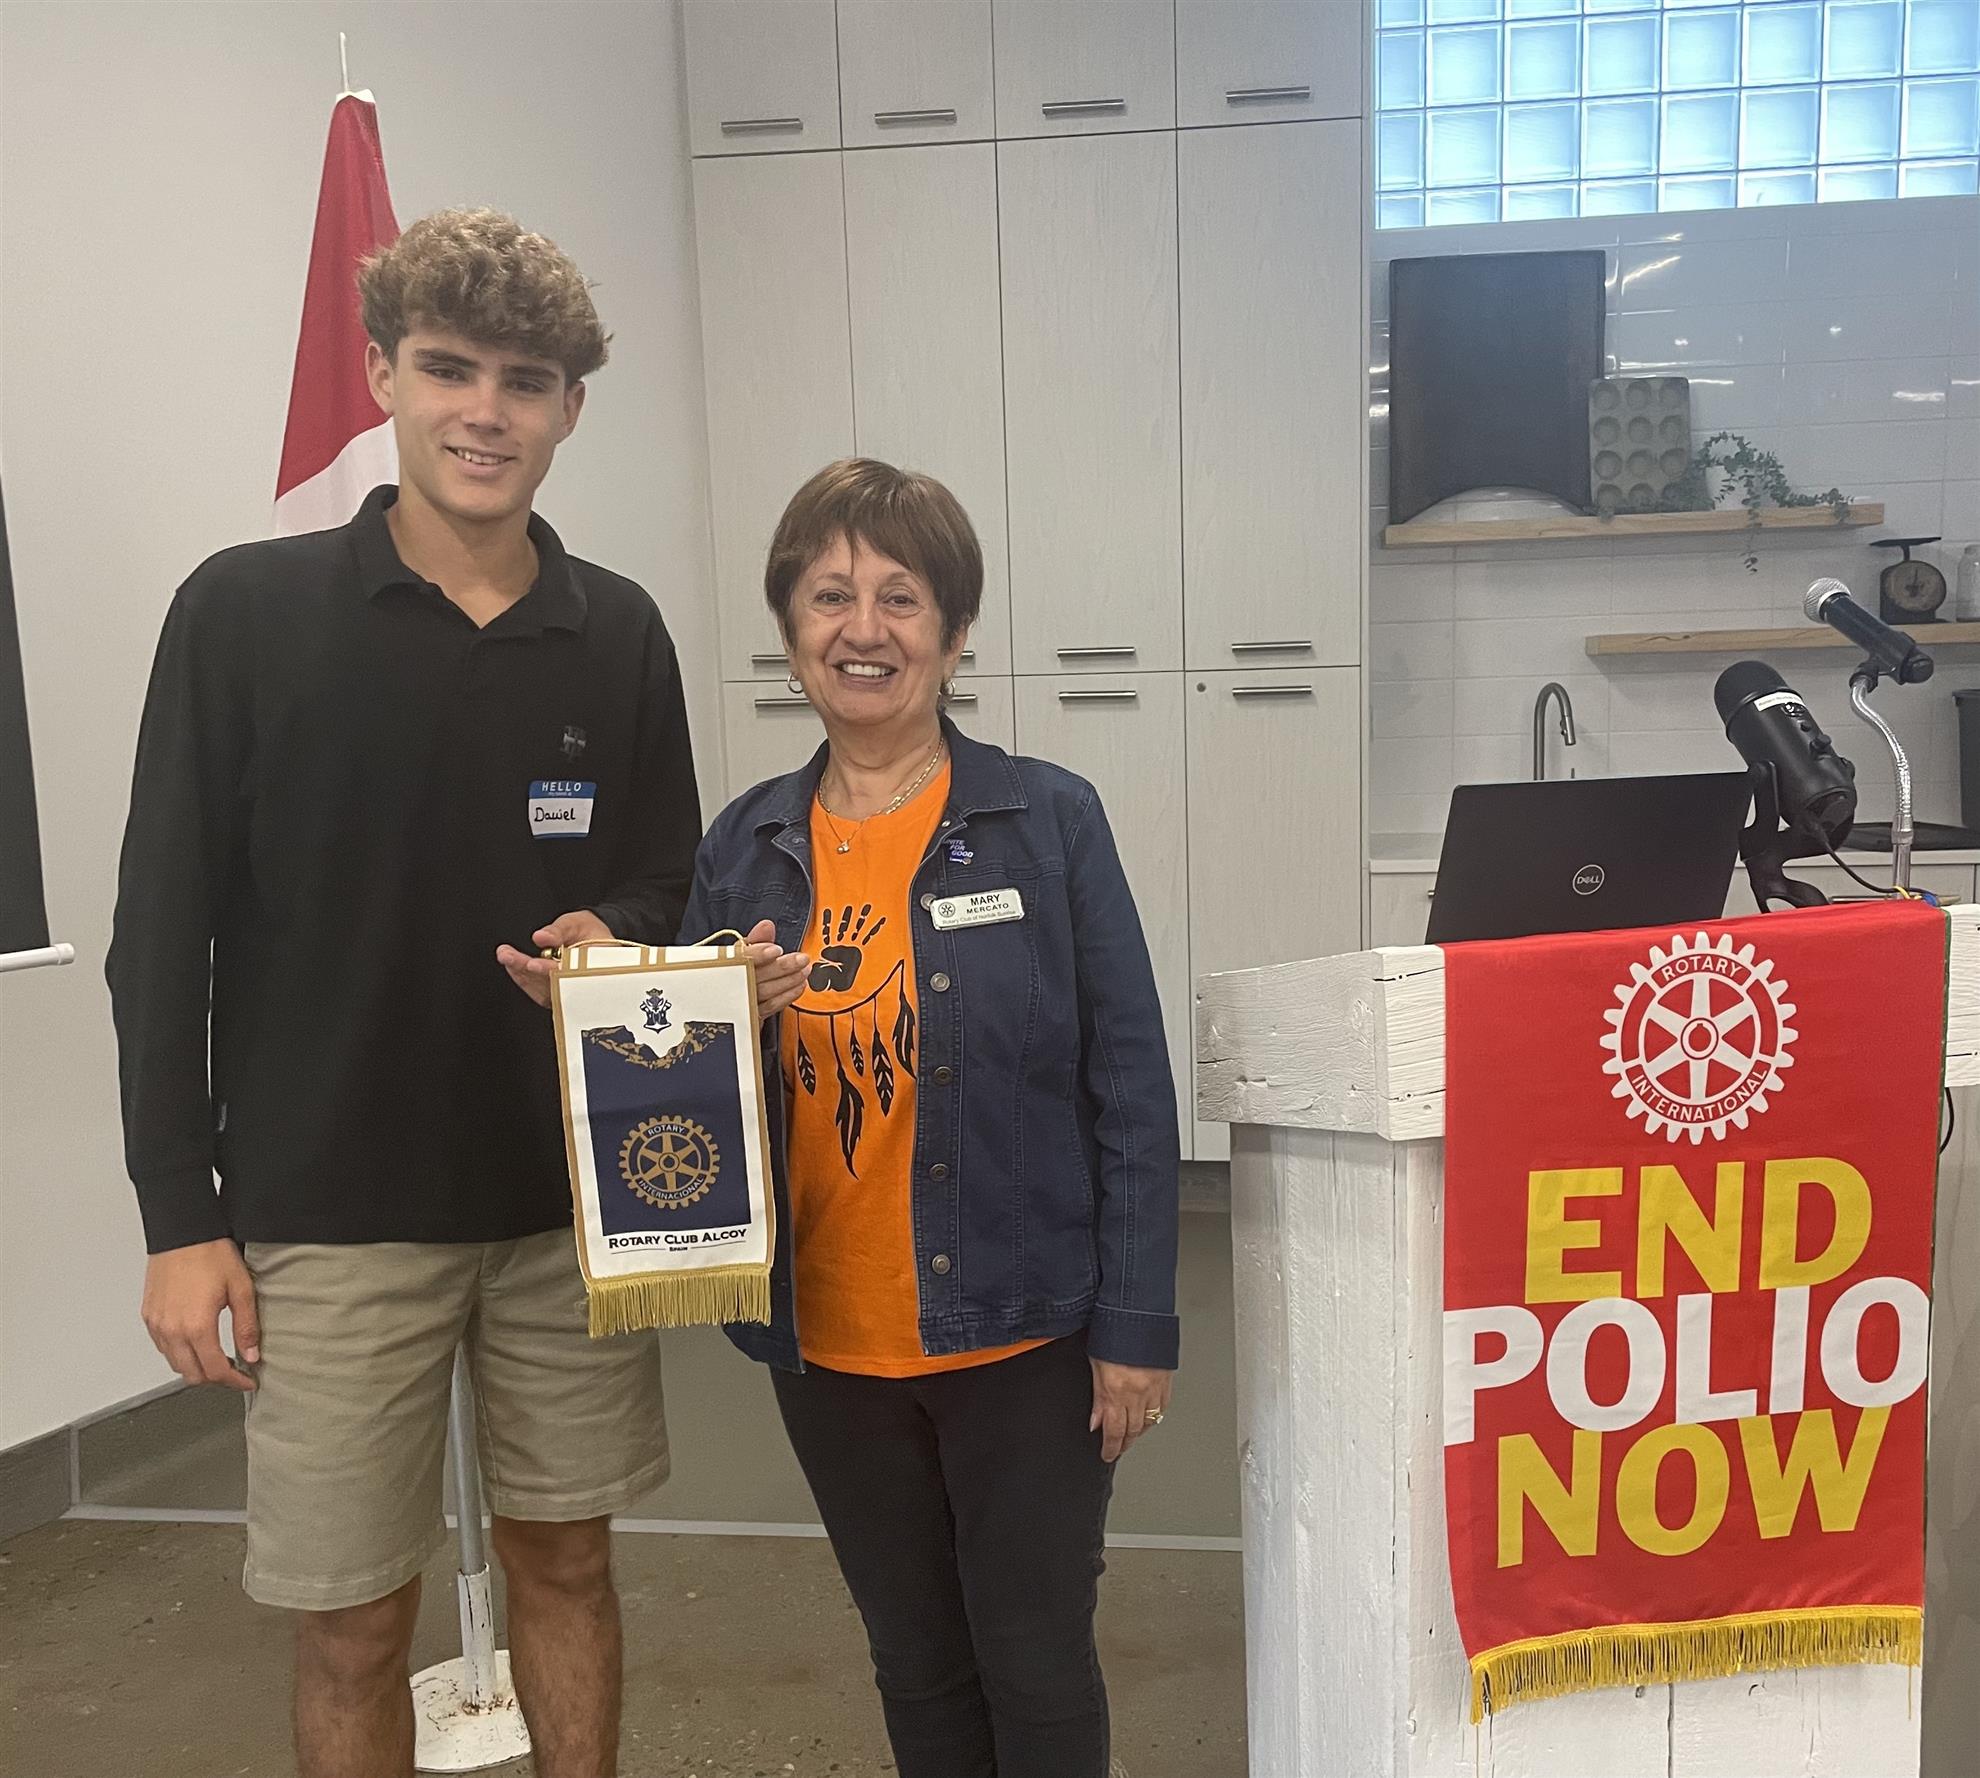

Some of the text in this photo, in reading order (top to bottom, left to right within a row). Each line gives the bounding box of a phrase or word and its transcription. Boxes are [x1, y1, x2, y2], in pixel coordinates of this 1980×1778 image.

[542, 782, 581, 792] HELLO
[952, 850, 973, 858] GOOD
[1577, 875, 1601, 885] DELL
[966, 902, 1009, 914] MERCATO
[970, 893, 1000, 906] MARY
[1661, 955, 1743, 982] ROTARY
[1631, 1069, 1768, 1122] INTERNATIONAL
[647, 1124, 686, 1136] ROTARY
[638, 1177, 704, 1200] INTERNACIONAL
[608, 1228, 747, 1249] ROTARY CLUB ALCOY
[1524, 1156, 1873, 1304] END
[1444, 1276, 1931, 1446] POLIO
[1497, 1406, 1892, 1568] NOW
